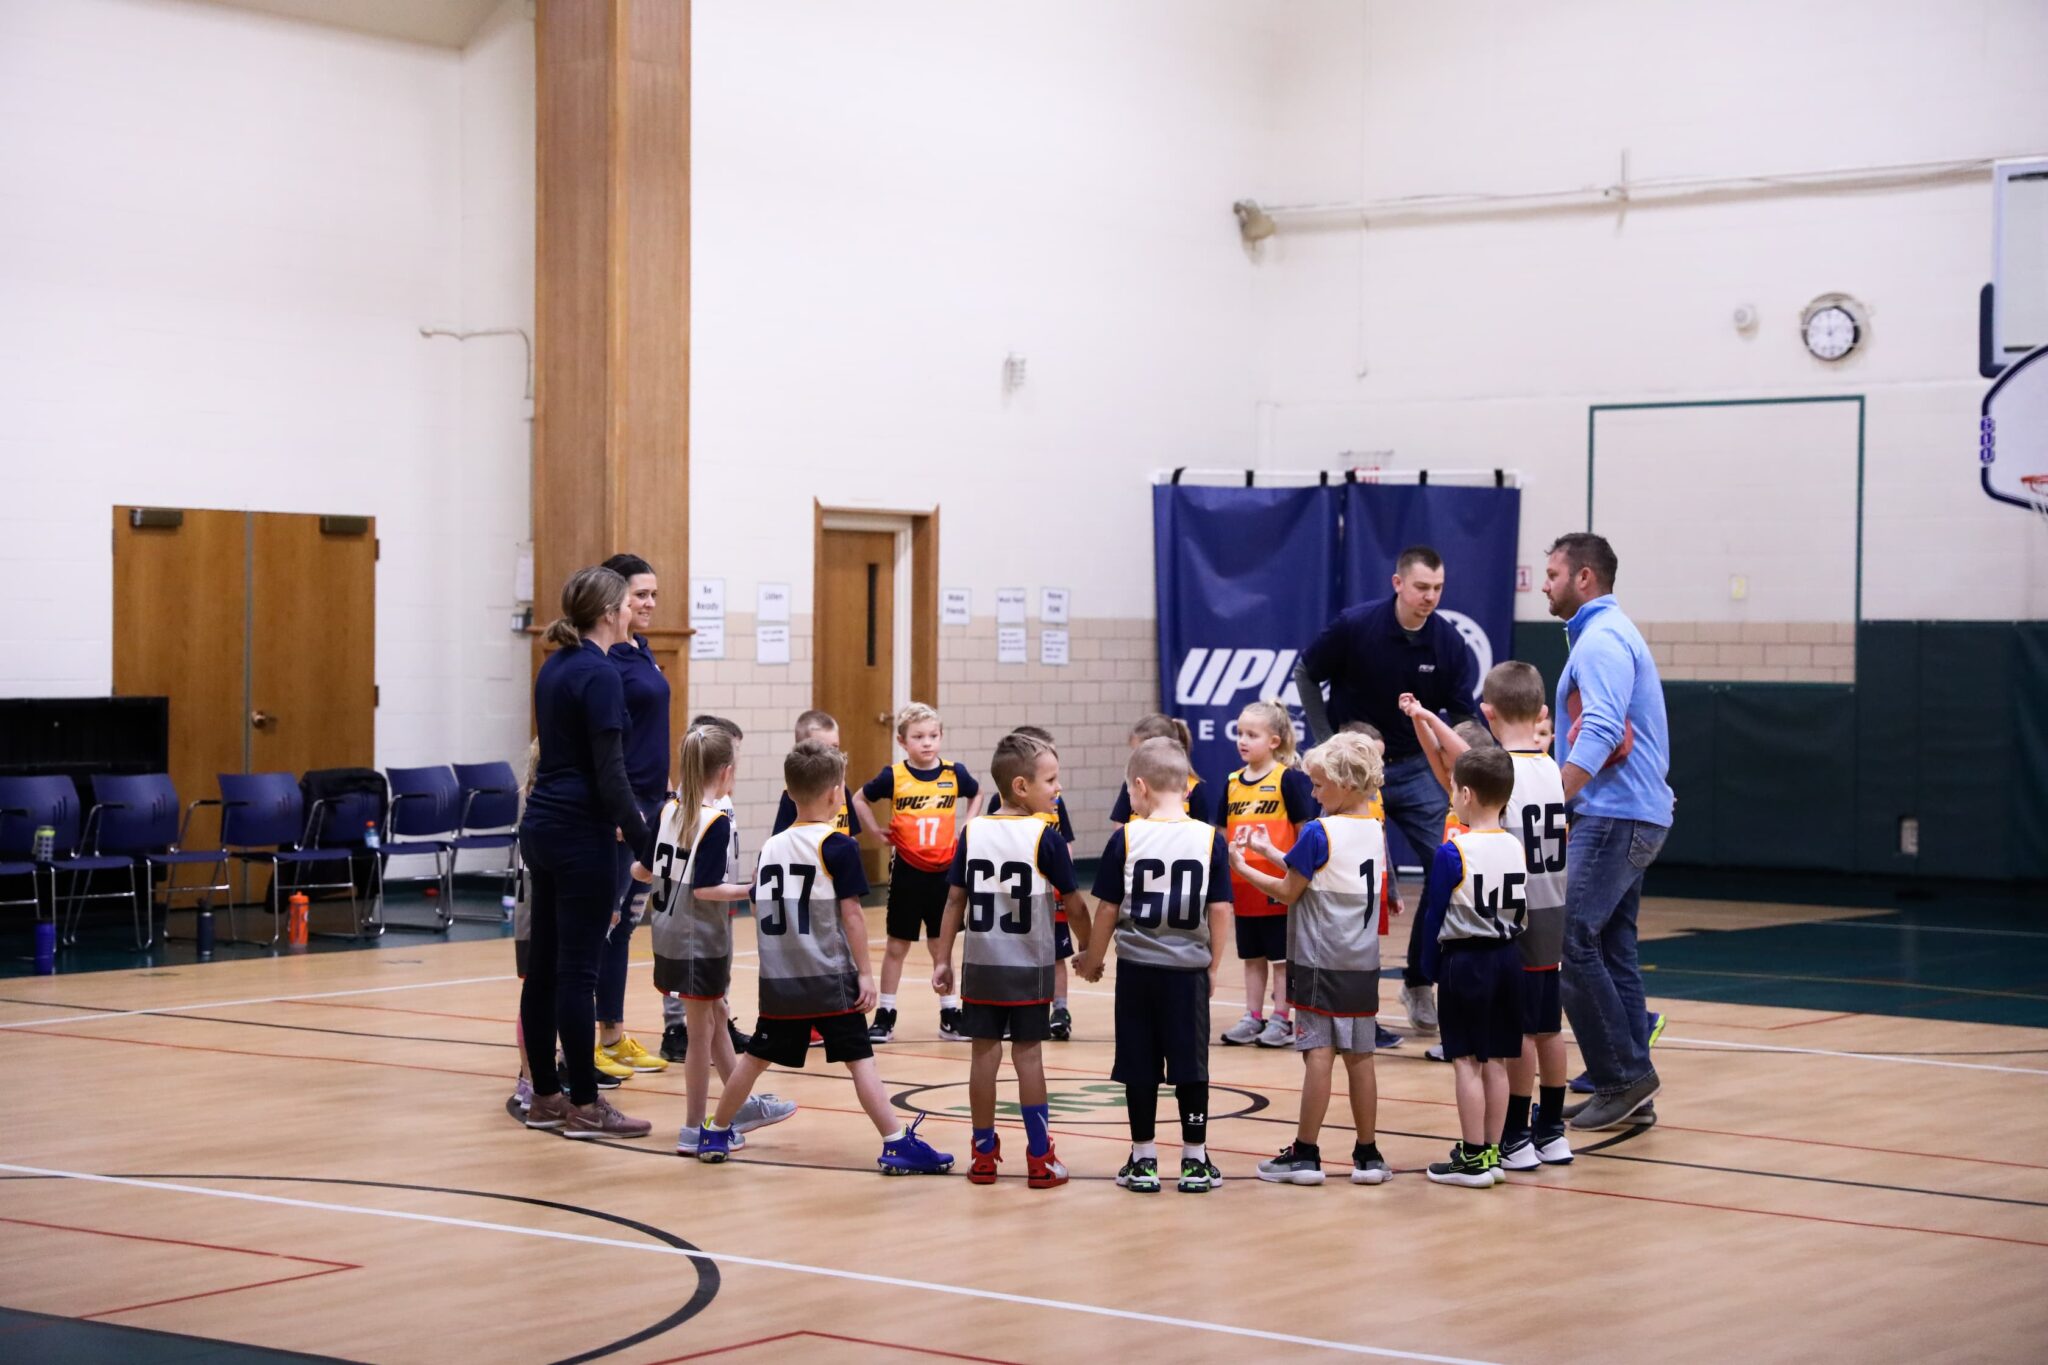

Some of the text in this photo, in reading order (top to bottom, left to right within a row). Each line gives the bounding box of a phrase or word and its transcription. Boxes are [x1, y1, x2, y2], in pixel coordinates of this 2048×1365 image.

[916, 817, 940, 847] 17
[1522, 803, 1567, 874] 65
[653, 842, 692, 916] 37
[760, 863, 816, 935] 37
[967, 859, 1032, 934] 63
[1130, 858, 1204, 930] 60
[1359, 859, 1375, 929] 1
[1473, 873, 1526, 939] 45
